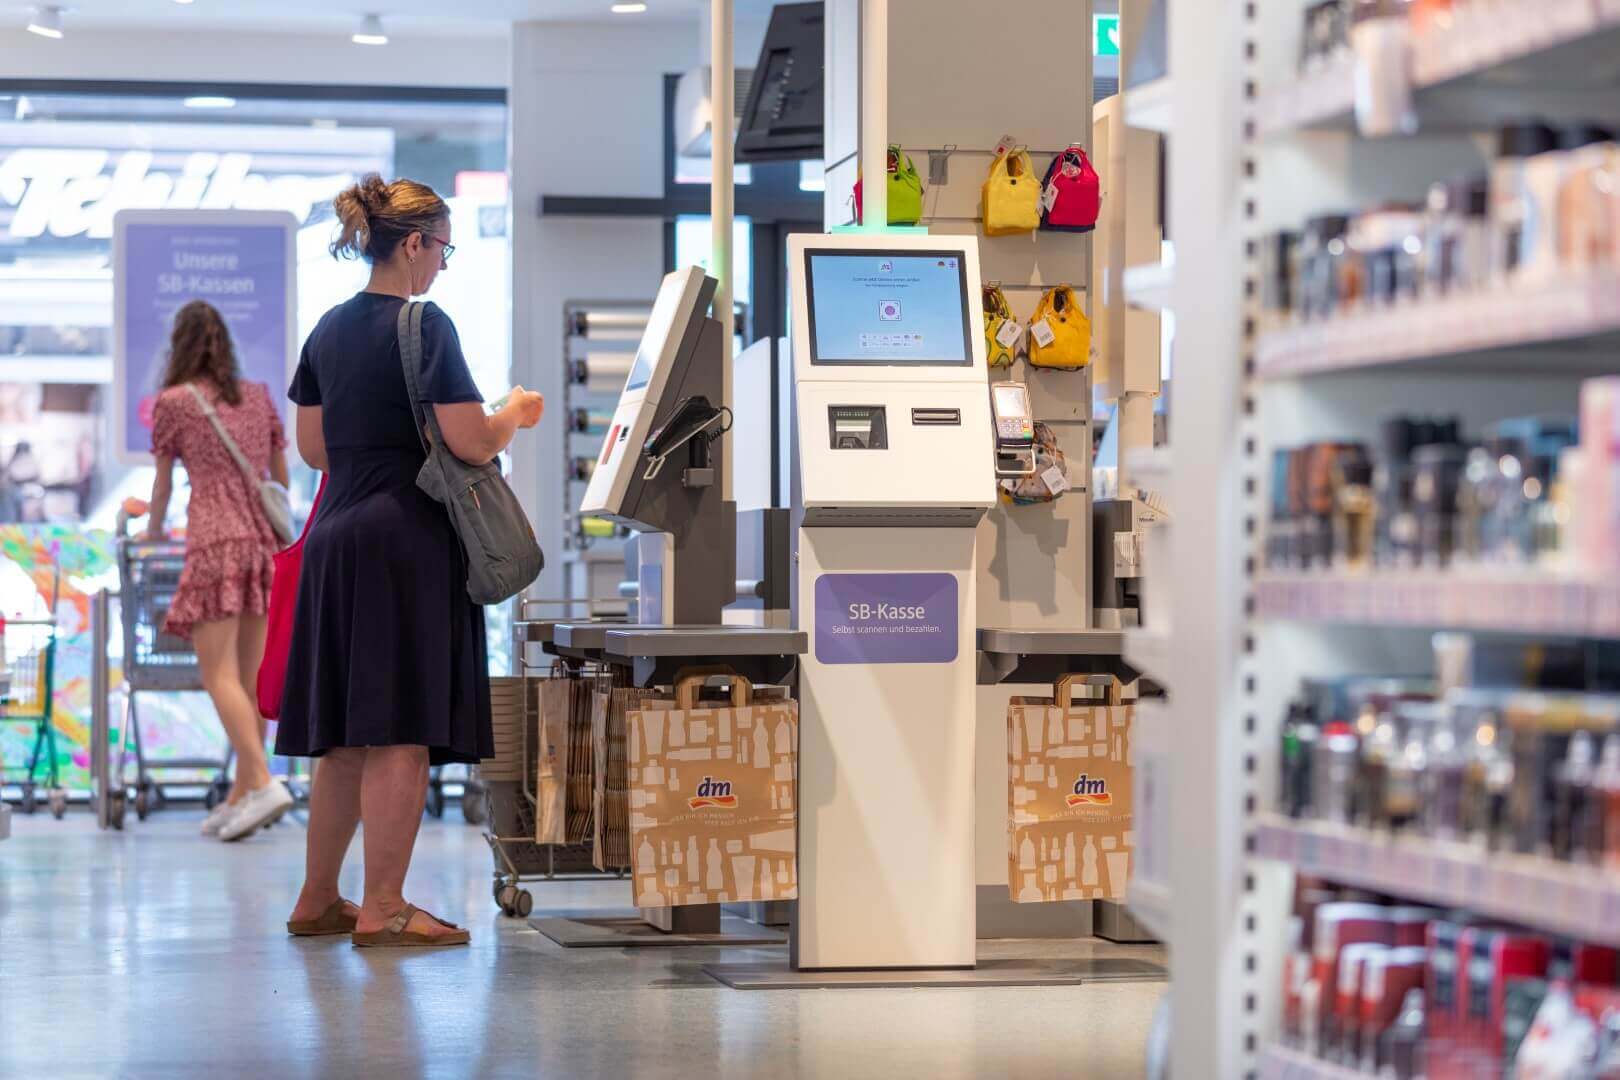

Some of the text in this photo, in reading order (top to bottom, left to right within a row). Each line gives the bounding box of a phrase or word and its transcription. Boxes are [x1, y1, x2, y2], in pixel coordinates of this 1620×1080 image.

[174, 251, 239, 270] Unsere
[159, 274, 255, 293] SB-Kassen
[849, 603, 925, 620] SB-Kasse
[832, 624, 941, 634] Selbst scannen und bezahlen.
[697, 777, 731, 797] dm
[1074, 775, 1105, 795] dm
